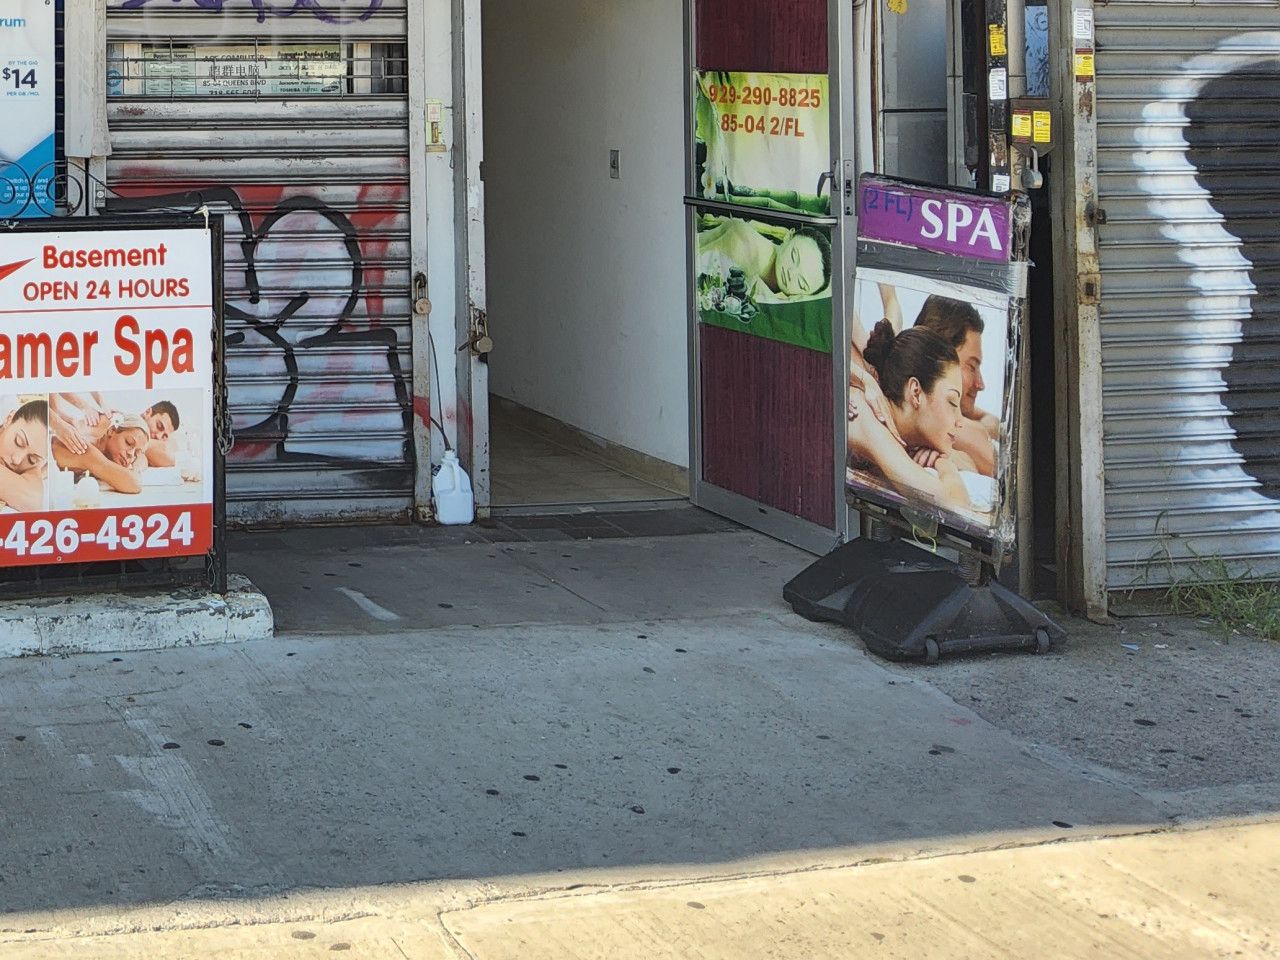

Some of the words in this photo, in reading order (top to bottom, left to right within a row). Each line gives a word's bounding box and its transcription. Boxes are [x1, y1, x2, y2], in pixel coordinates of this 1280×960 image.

[2, 66, 38, 89] $14
[708, 85, 821, 109] 929-290-8825
[721, 113, 766, 135] 85-04
[770, 116, 805, 137] 2/FL
[920, 198, 1003, 252] SPA
[43, 242, 168, 269] Basement
[23, 281, 79, 301] OPEN
[86, 279, 112, 300] 24
[118, 277, 190, 299] HOURS
[113, 314, 195, 390] Spa
